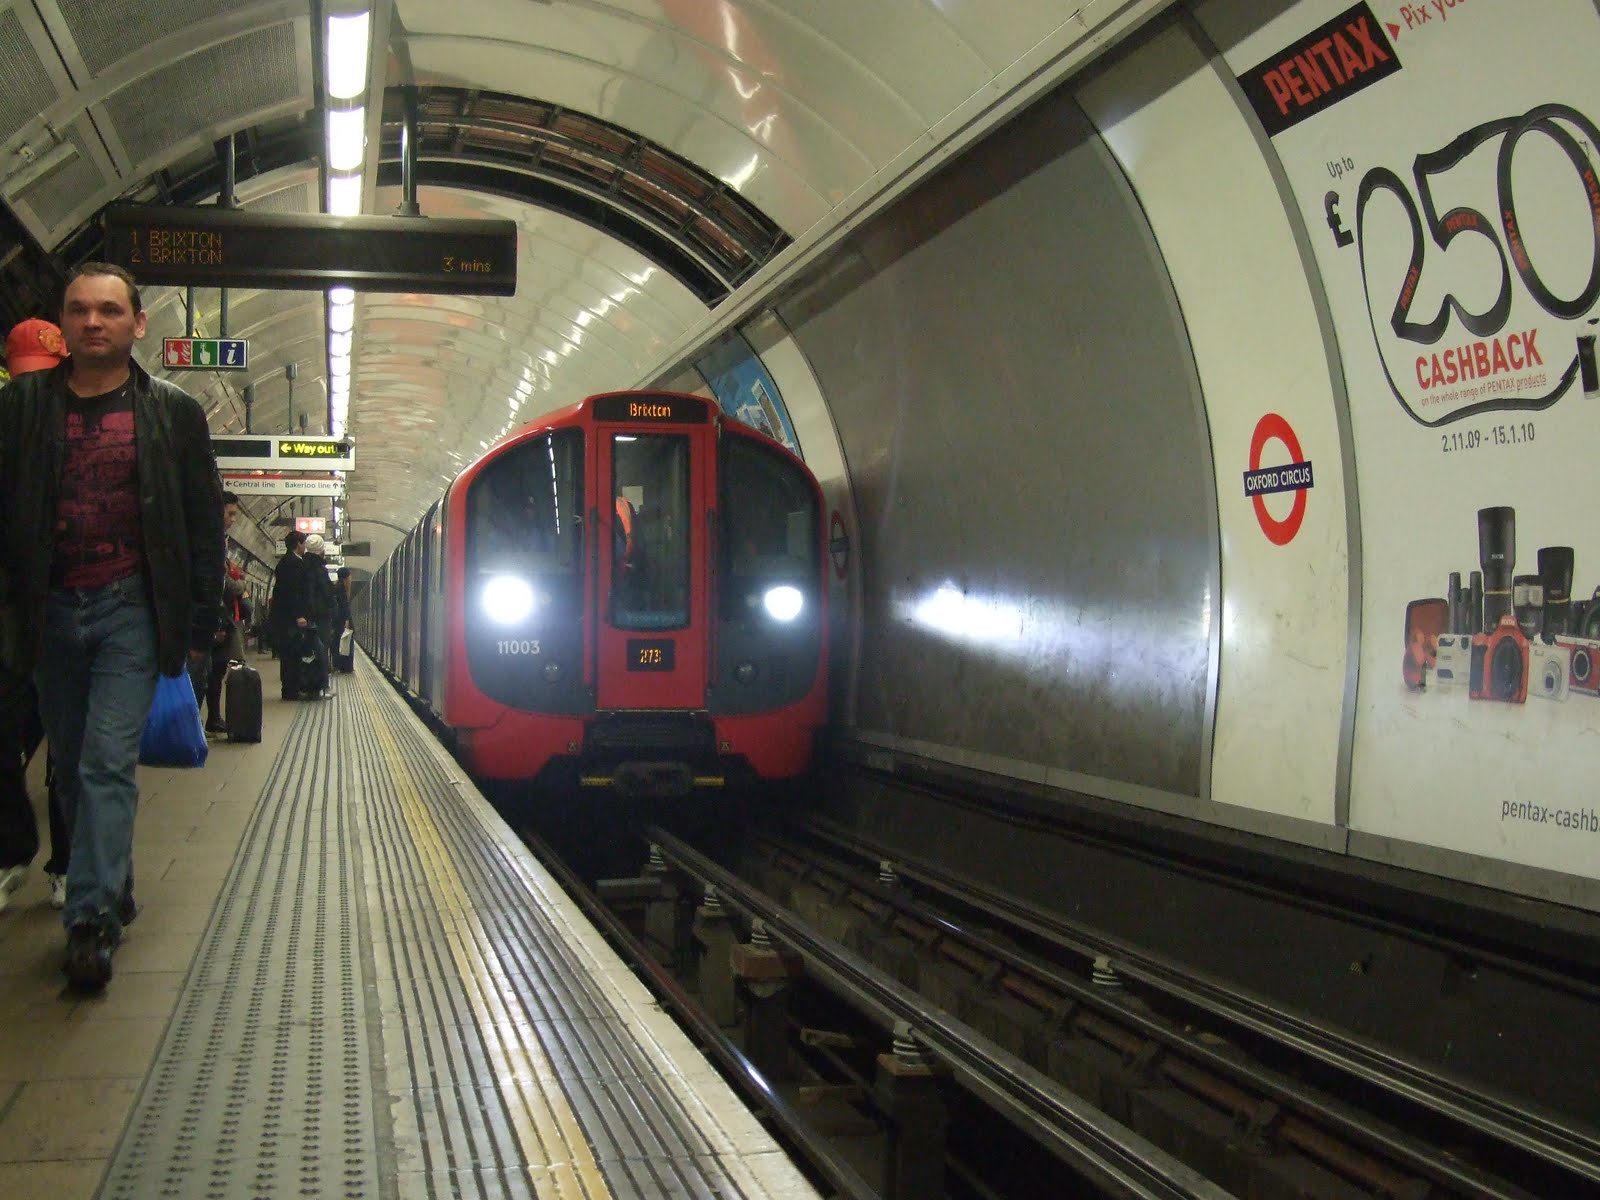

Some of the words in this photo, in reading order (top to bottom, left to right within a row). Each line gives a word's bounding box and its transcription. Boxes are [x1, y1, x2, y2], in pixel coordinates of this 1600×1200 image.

[1400, 4, 1432, 30] Pix
[1262, 15, 1390, 116] PENTAX
[1326, 161, 1343, 180] Up
[1342, 157, 1355, 172] to
[130, 229, 138, 246] 1
[150, 230, 222, 247] BRIXTON
[130, 248, 141, 263] 2
[150, 248, 222, 265] BRIXTON
[443, 256, 455, 273] 3
[460, 260, 492, 272] mins
[1415, 328, 1543, 390] CASHBACK
[1430, 395, 1440, 405] the
[1441, 391, 1459, 402] whole
[1460, 388, 1479, 401] range
[1480, 385, 1487, 395] of
[1487, 378, 1515, 393] PENTAX
[1517, 373, 1547, 392] products
[630, 403, 671, 417] Brixton
[293, 444, 317, 455] Way
[317, 444, 335, 454] out
[1442, 430, 1480, 452] 2.11.09
[1492, 422, 1535, 445] 15.1.10
[1247, 473, 1278, 490] OXFORD
[1280, 468, 1311, 485] CIRCUS
[497, 640, 540, 655] 11003
[1501, 800, 1600, 832] pentax-cashb
